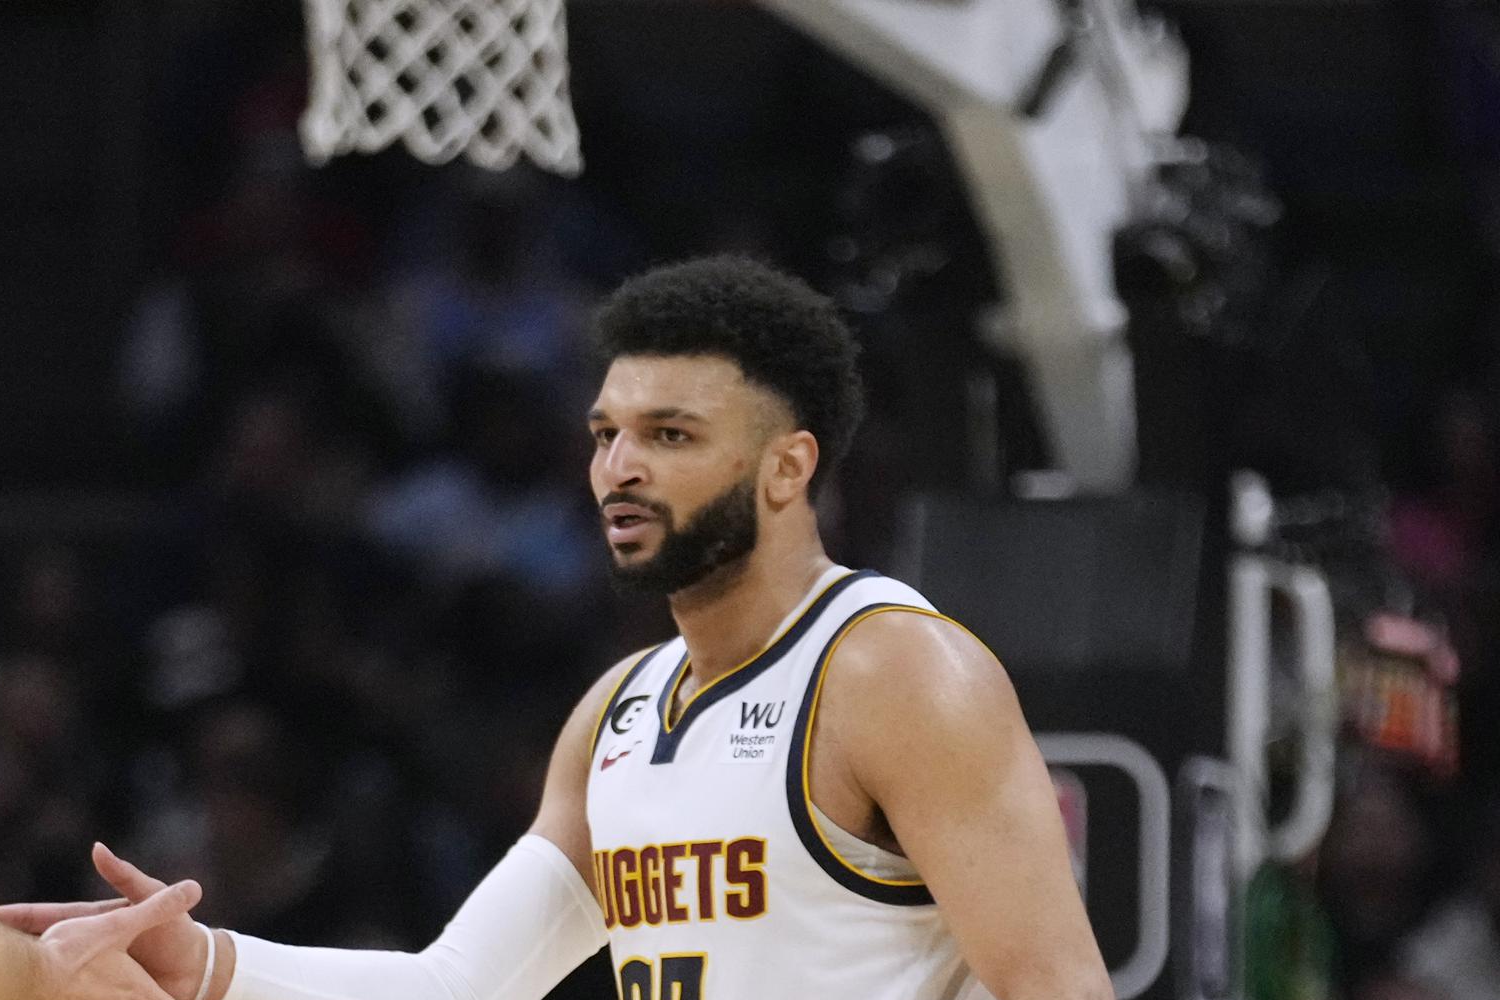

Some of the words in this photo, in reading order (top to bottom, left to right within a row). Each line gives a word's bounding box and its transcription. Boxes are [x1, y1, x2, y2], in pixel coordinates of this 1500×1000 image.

[740, 700, 786, 730] WU
[730, 734, 775, 746] Western
[733, 746, 765, 759] Union
[593, 836, 768, 931] UGGETS
